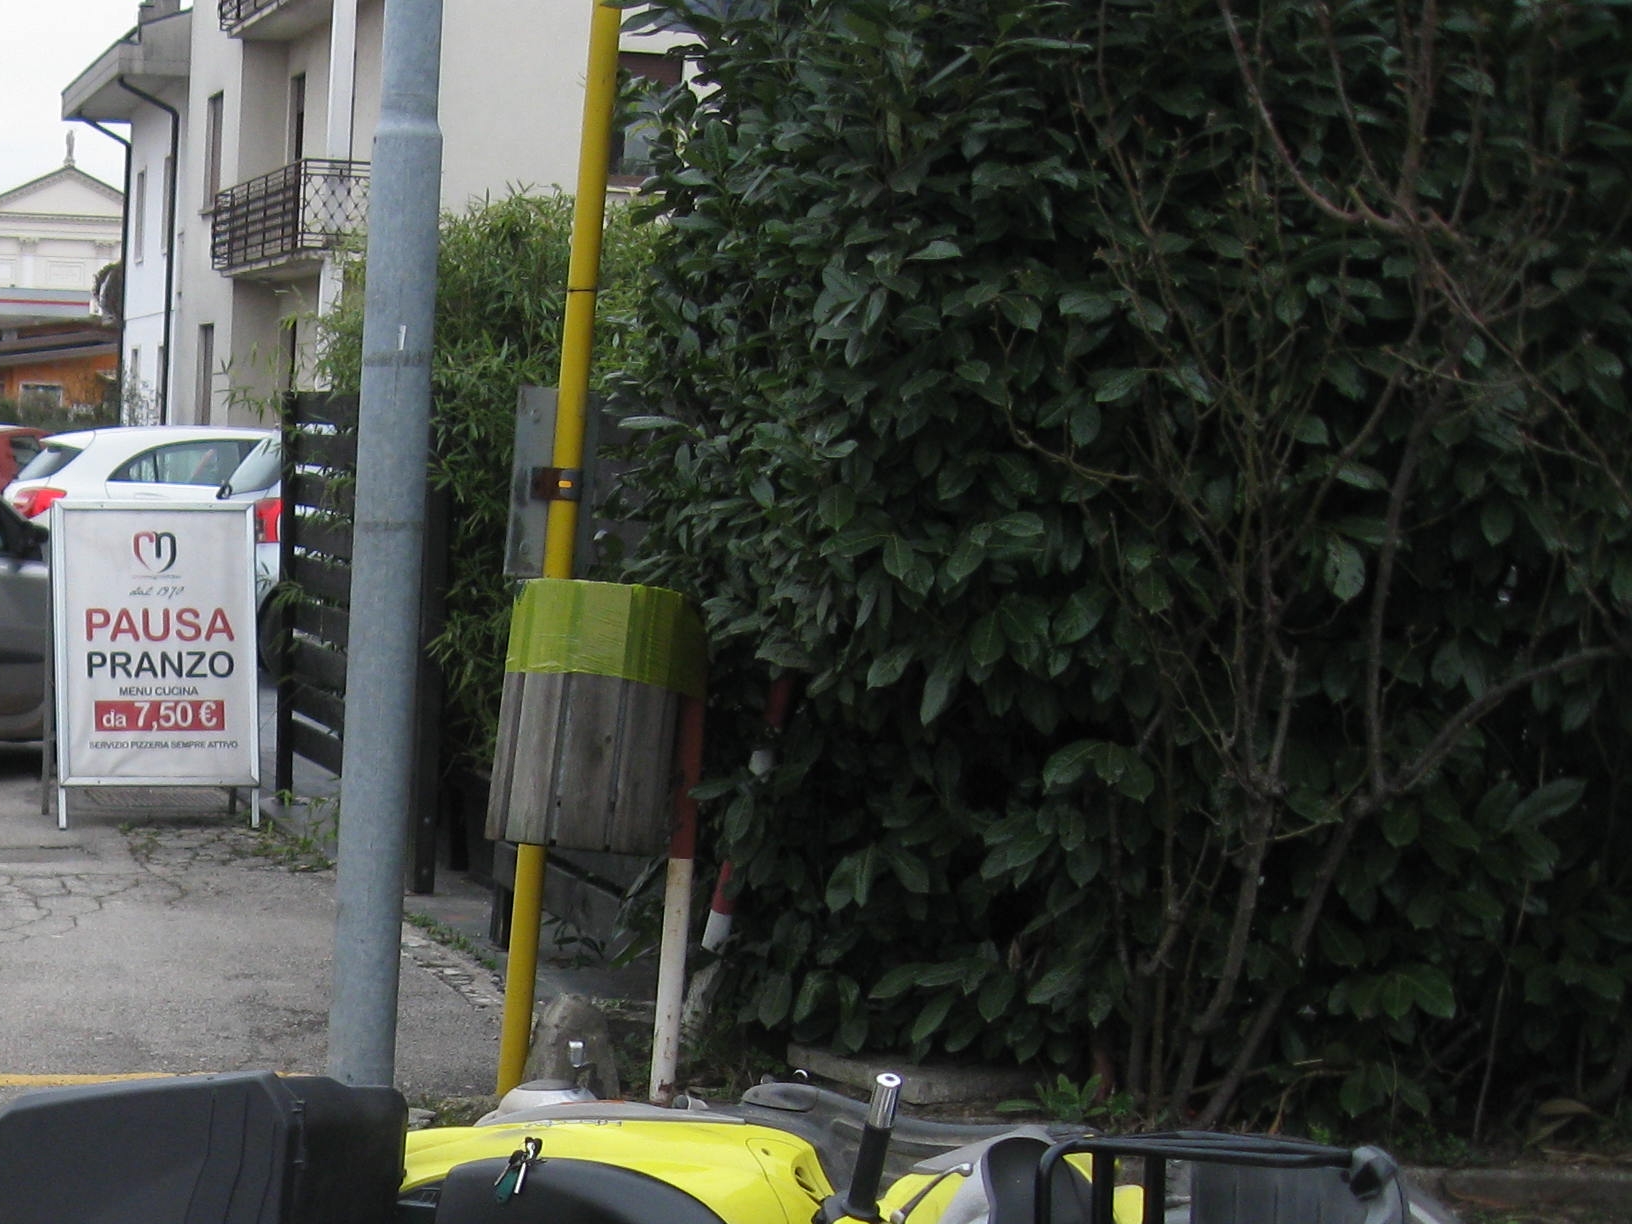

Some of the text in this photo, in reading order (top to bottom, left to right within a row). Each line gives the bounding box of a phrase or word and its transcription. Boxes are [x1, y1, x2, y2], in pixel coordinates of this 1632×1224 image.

[85, 607, 235, 642] PAUSA
[87, 651, 235, 679] PRANZO
[119, 686, 199, 697] MENU CUCINA
[102, 702, 218, 731] da 7,50 €
[89, 740, 239, 750] SERVIZIO PIZZERIA SEMPRE ATTIVO
